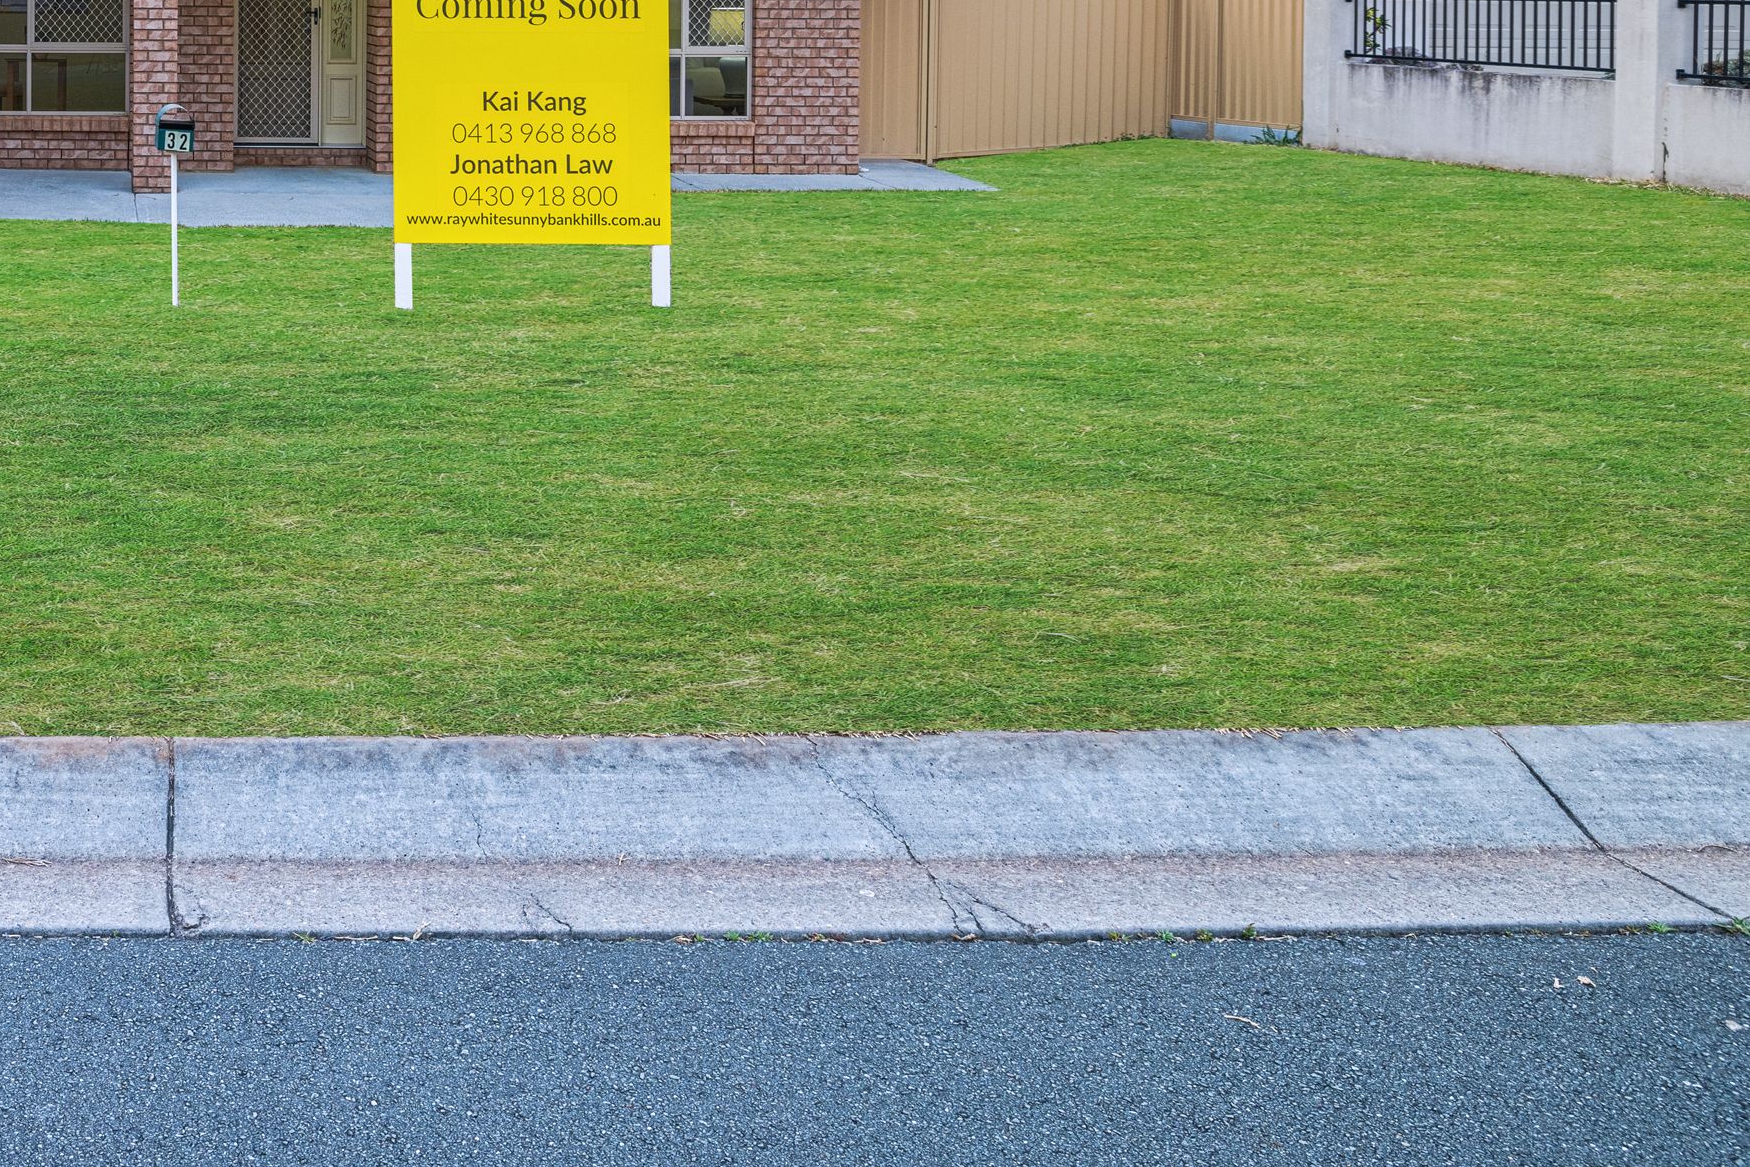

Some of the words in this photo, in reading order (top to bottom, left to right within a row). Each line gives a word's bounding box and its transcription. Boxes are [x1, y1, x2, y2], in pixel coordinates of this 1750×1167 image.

[482, 90, 519, 112] Kai
[527, 90, 587, 117] Kang
[167, 132, 188, 151] 32
[451, 122, 513, 144] 0413
[520, 122, 565, 144] 968
[571, 122, 617, 144] 868
[449, 153, 558, 175] Jonathan
[565, 153, 614, 175] Law
[452, 185, 515, 207] 0430
[520, 185, 566, 207] 918
[572, 185, 619, 207] 800
[406, 212, 662, 228] www.raywhitesunnybankhills.com.au
